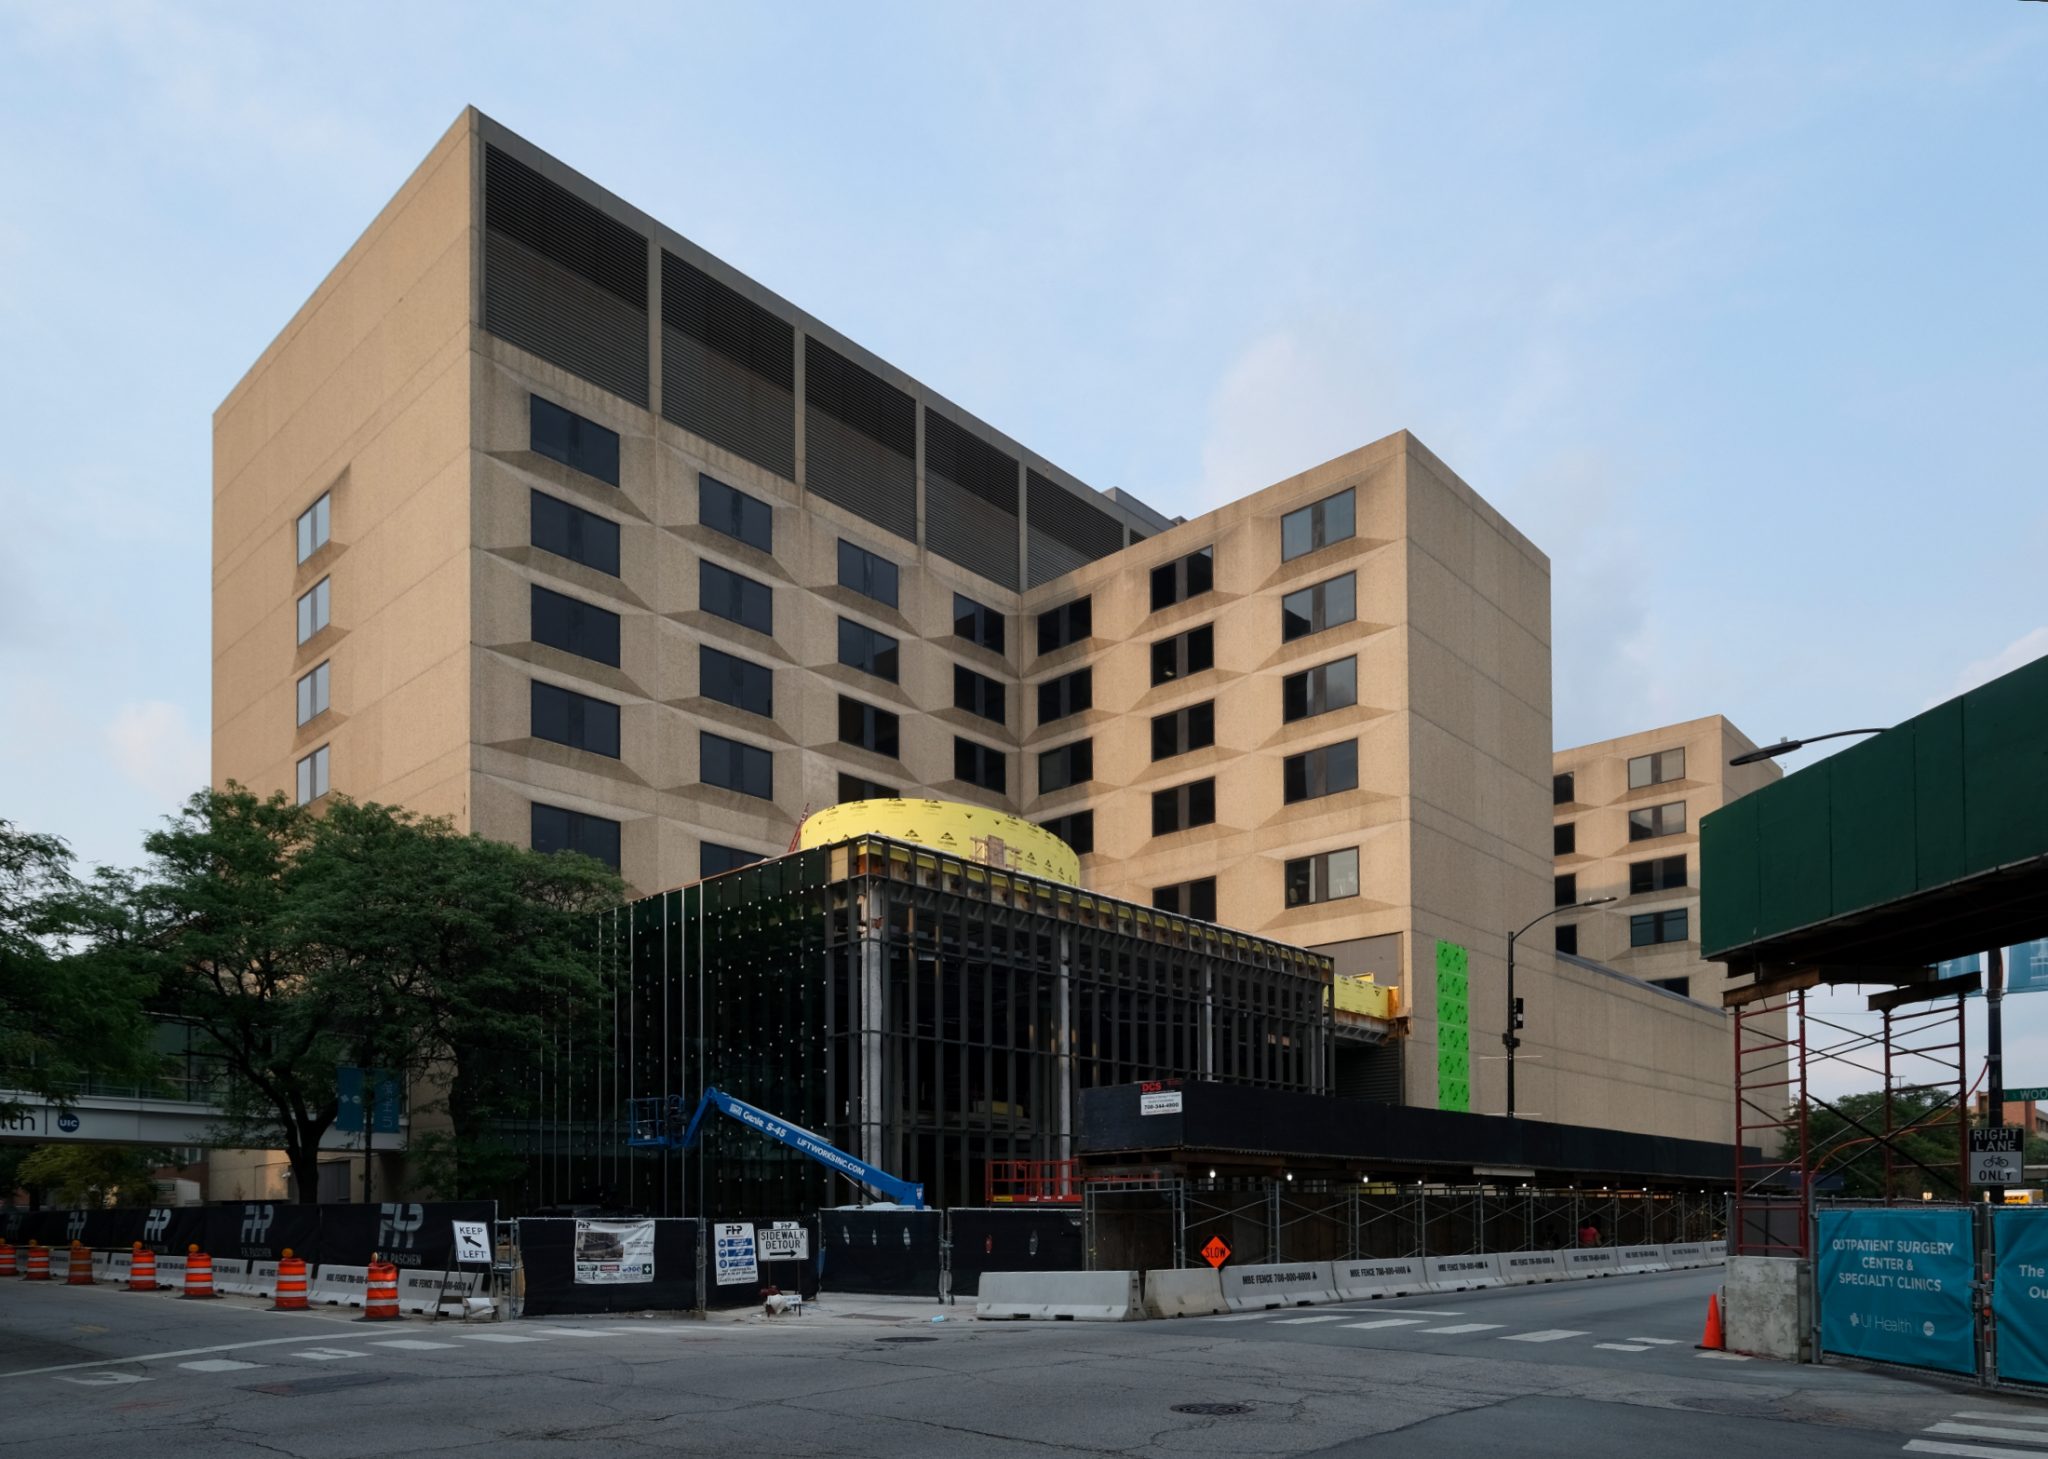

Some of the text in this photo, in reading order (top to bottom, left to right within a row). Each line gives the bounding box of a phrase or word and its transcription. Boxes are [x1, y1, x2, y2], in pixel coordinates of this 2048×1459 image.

[1142, 1082, 1161, 1091] DCS
[766, 1122, 787, 1138] S-45
[1973, 1129, 2019, 1140] RIGHT
[1975, 1141, 2016, 1152] LANE
[1979, 1171, 2011, 1181] ONLY
[460, 1227, 484, 1235] KEEP
[760, 1231, 805, 1240] SIDEWALK
[766, 1240, 800, 1249] DETOUR
[1832, 1239, 1954, 1255] OUTPATIENT SURGERY
[463, 1251, 486, 1259] LEFT
[1206, 1247, 1226, 1257] SLOW
[1862, 1257, 1914, 1271] CENTER &
[2018, 1264, 2046, 1278] The
[1256, 1274, 1273, 1284] FENCE
[1838, 1272, 1942, 1292] SPECIALTY CLINICS
[1874, 1315, 1912, 1334] Health
